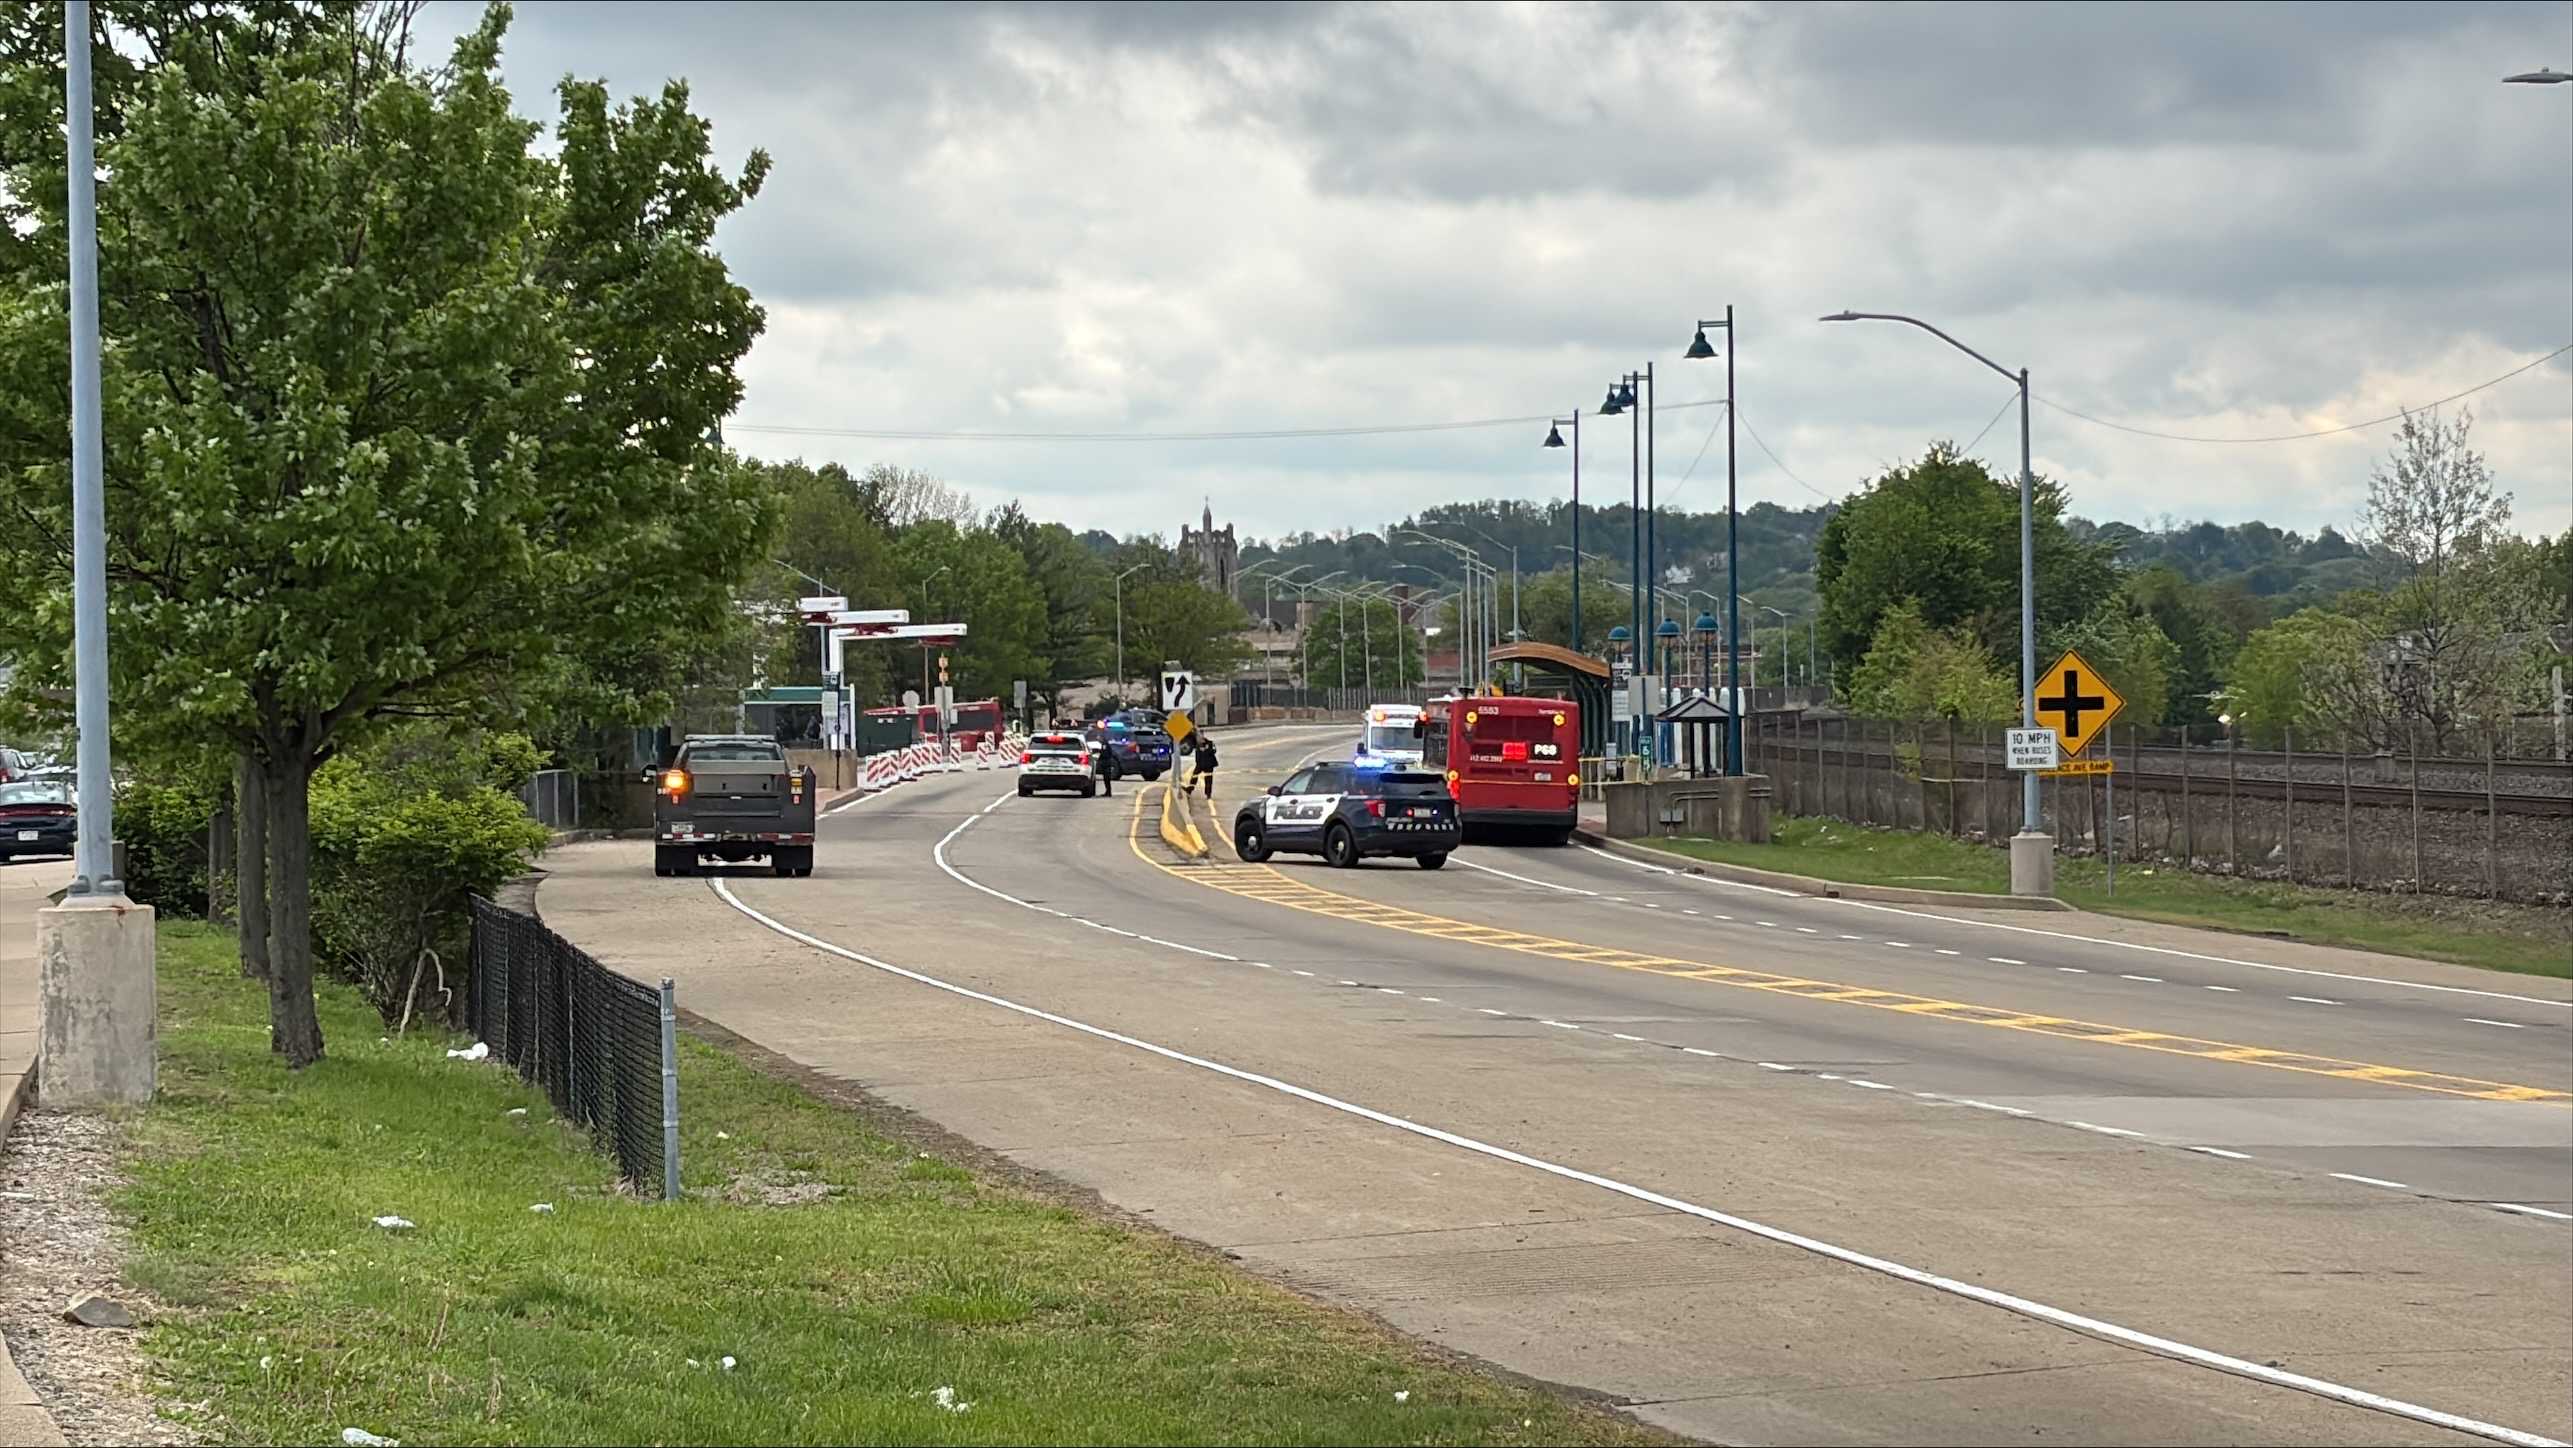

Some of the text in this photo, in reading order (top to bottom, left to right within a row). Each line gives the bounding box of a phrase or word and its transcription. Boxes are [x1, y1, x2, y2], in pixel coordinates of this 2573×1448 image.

[2012, 732, 2050, 744] 10 MPH
[2032, 746, 2051, 754] BUSES
[1273, 806, 1324, 820] POLICE
